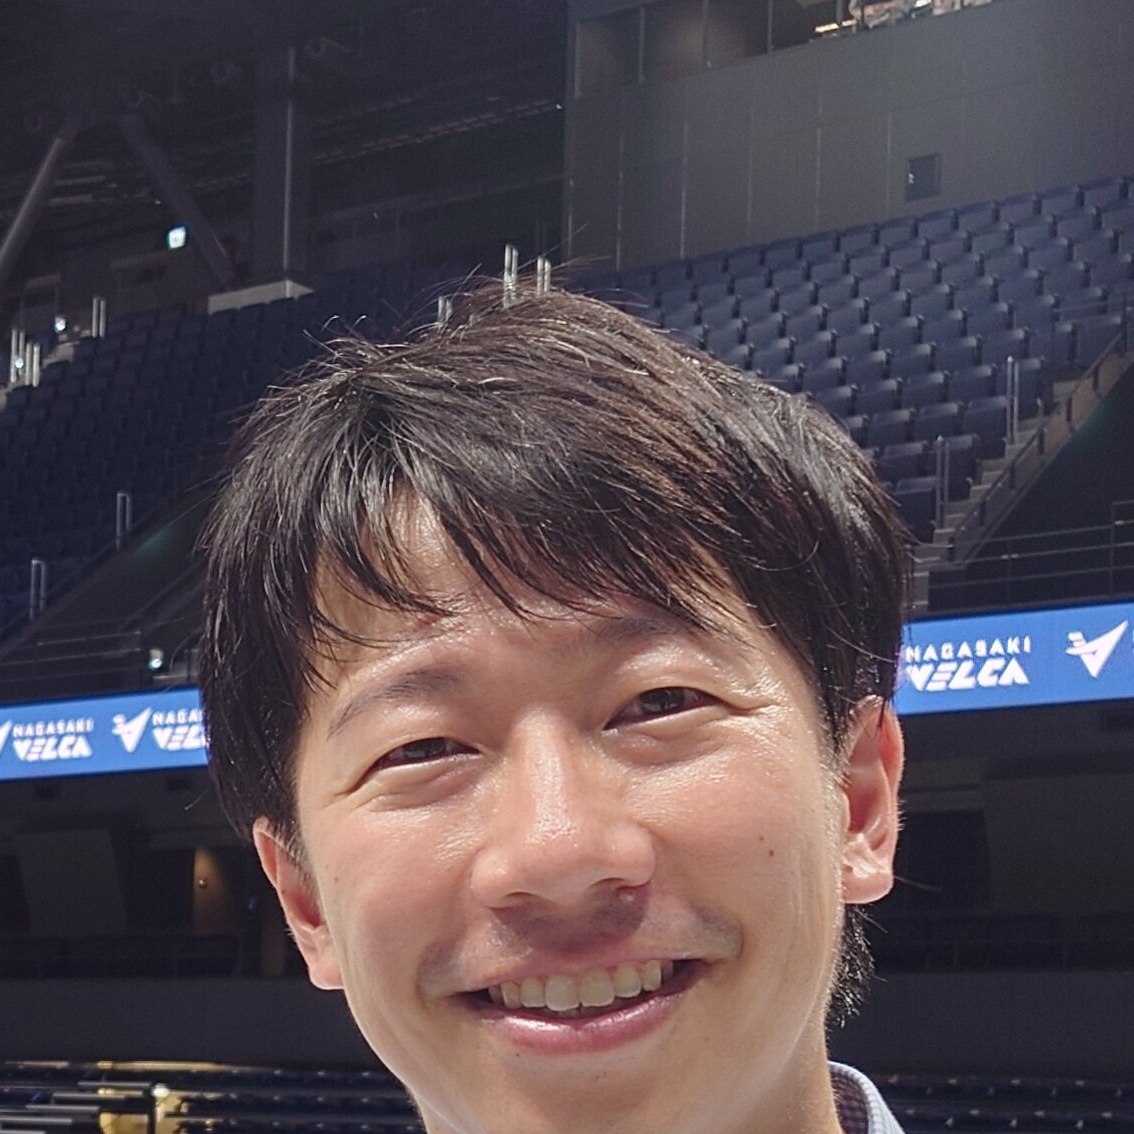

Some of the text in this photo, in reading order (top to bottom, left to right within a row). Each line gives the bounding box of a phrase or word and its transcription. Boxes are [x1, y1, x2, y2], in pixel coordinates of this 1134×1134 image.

[905, 636, 1031, 663] NAGASAKI
[905, 657, 1030, 692] VELCA
[13, 718, 94, 737] NAGASAKI
[13, 736, 92, 762] VELCA
